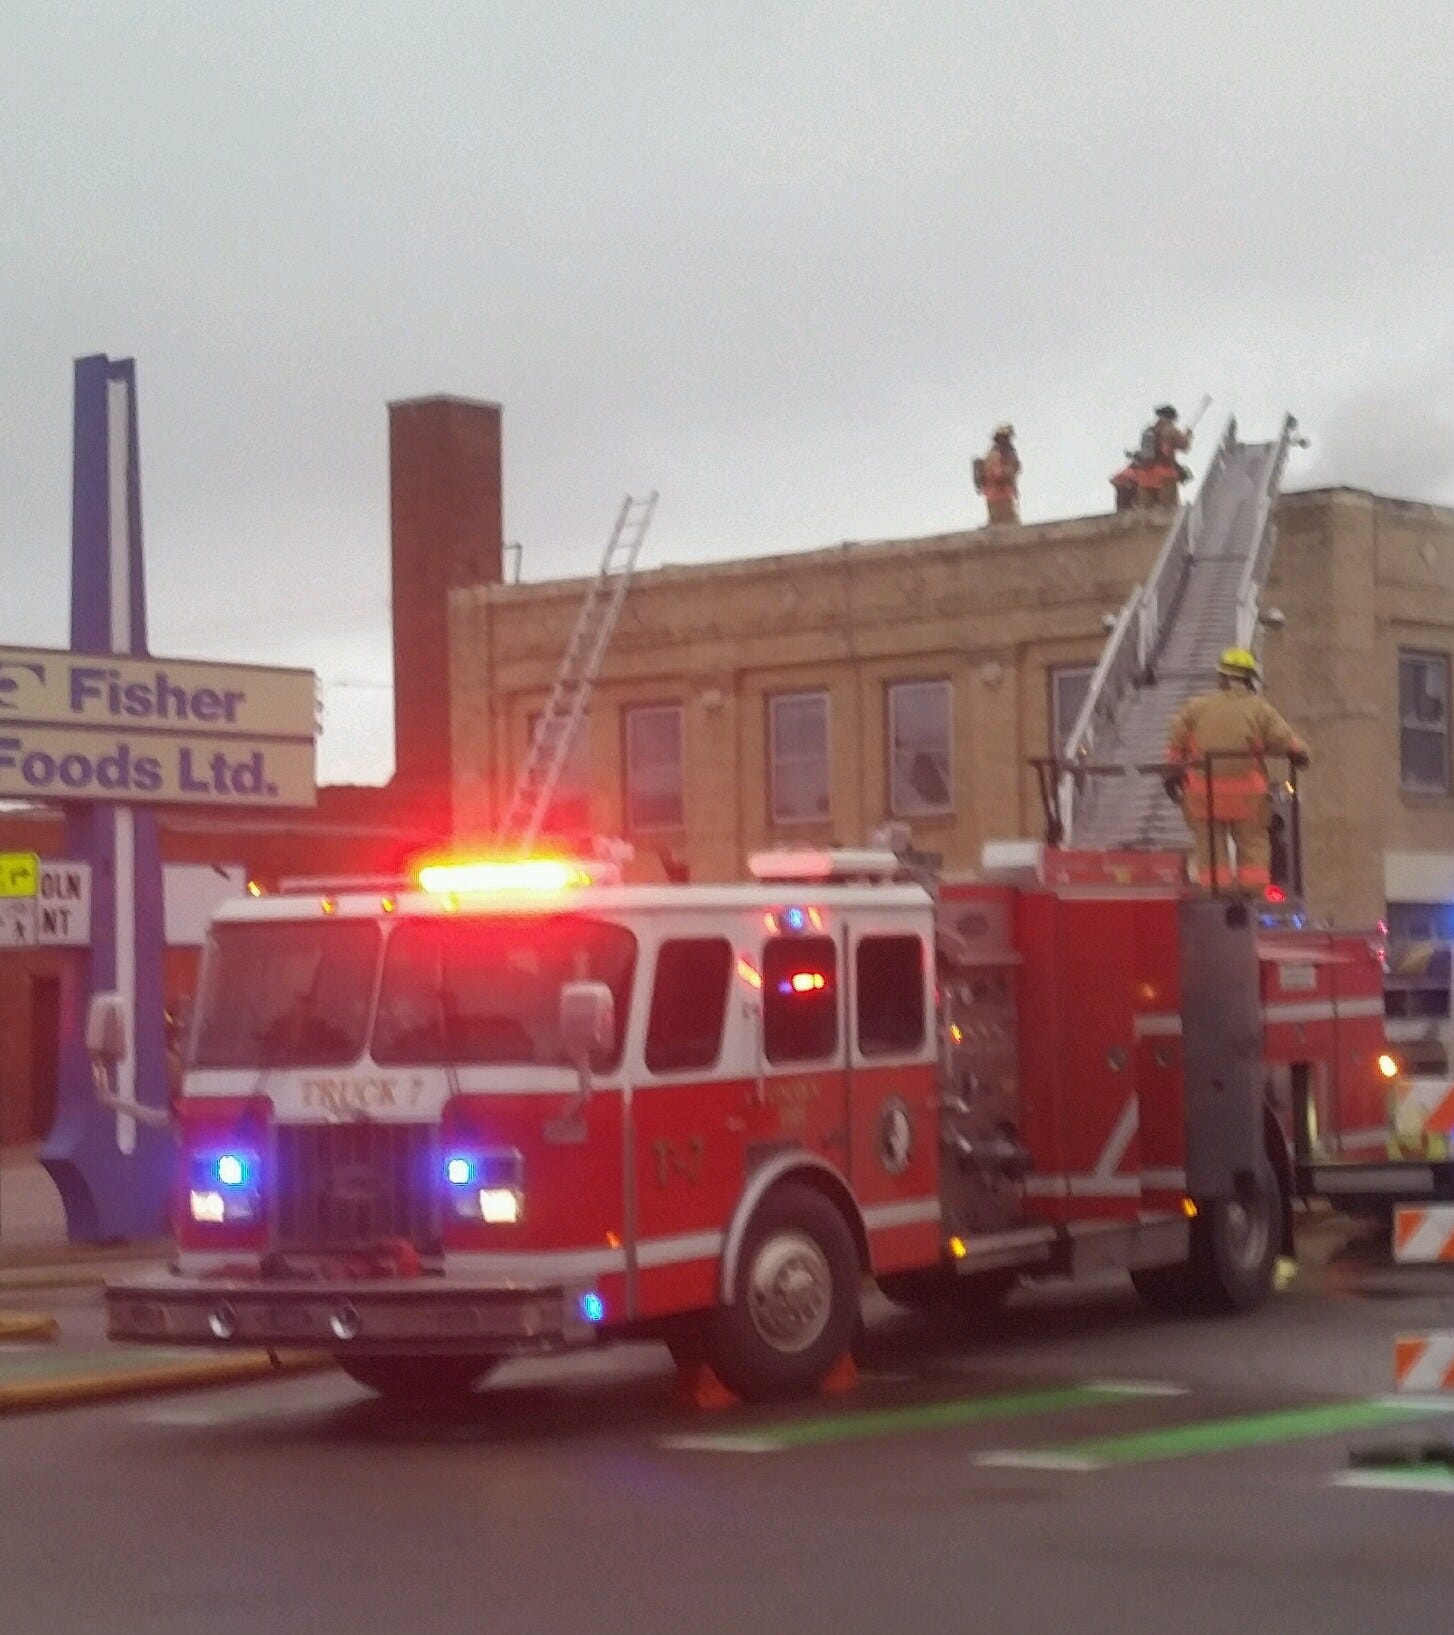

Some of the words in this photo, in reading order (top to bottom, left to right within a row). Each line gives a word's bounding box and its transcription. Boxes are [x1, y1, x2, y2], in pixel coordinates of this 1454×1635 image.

[69, 665, 246, 722] Fisher
[179, 747, 279, 797] Ltd.
[302, 1077, 398, 1107] TRUCK
